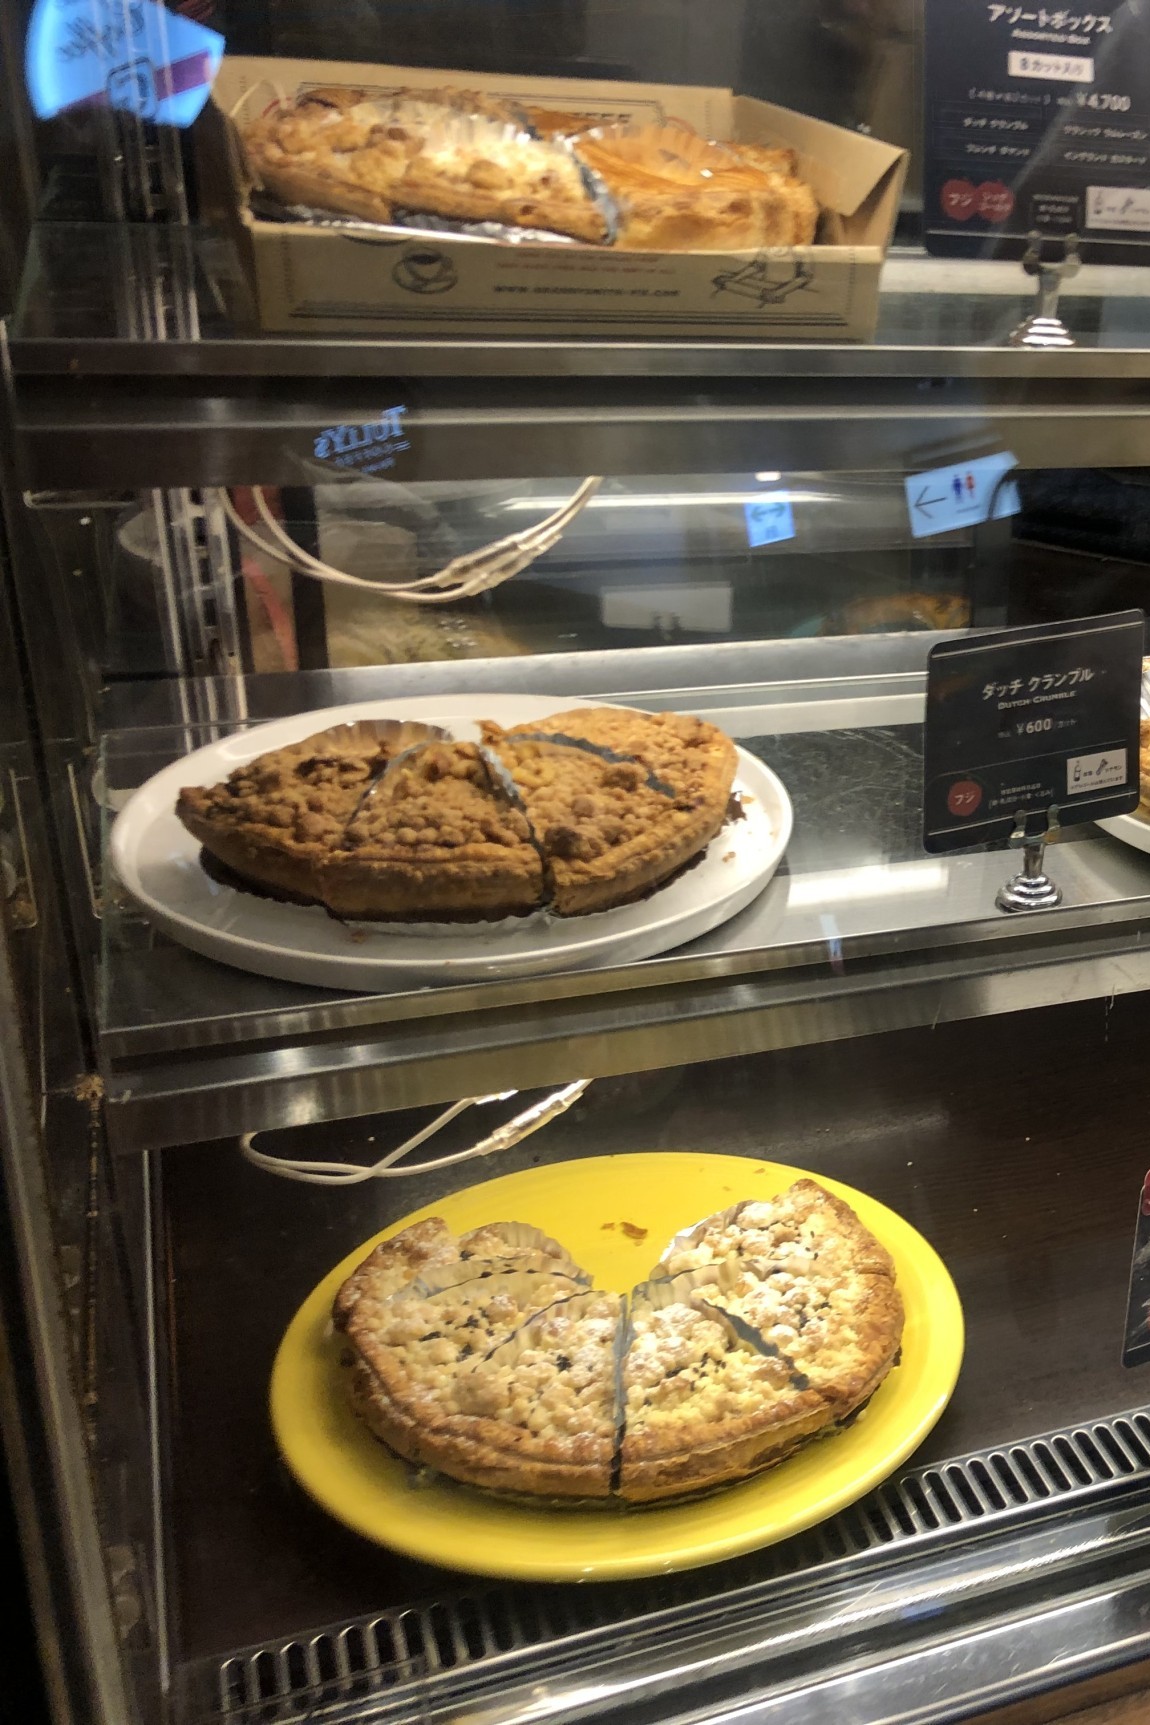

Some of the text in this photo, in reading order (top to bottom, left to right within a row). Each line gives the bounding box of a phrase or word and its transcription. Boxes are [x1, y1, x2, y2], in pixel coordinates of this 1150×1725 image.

[987, 3, 1113, 34] アソートボックス
[982, 667, 1095, 700] ダッチ クランブル
[1017, 719, 1052, 735] ¥600
[955, 792, 975, 806] フジ
